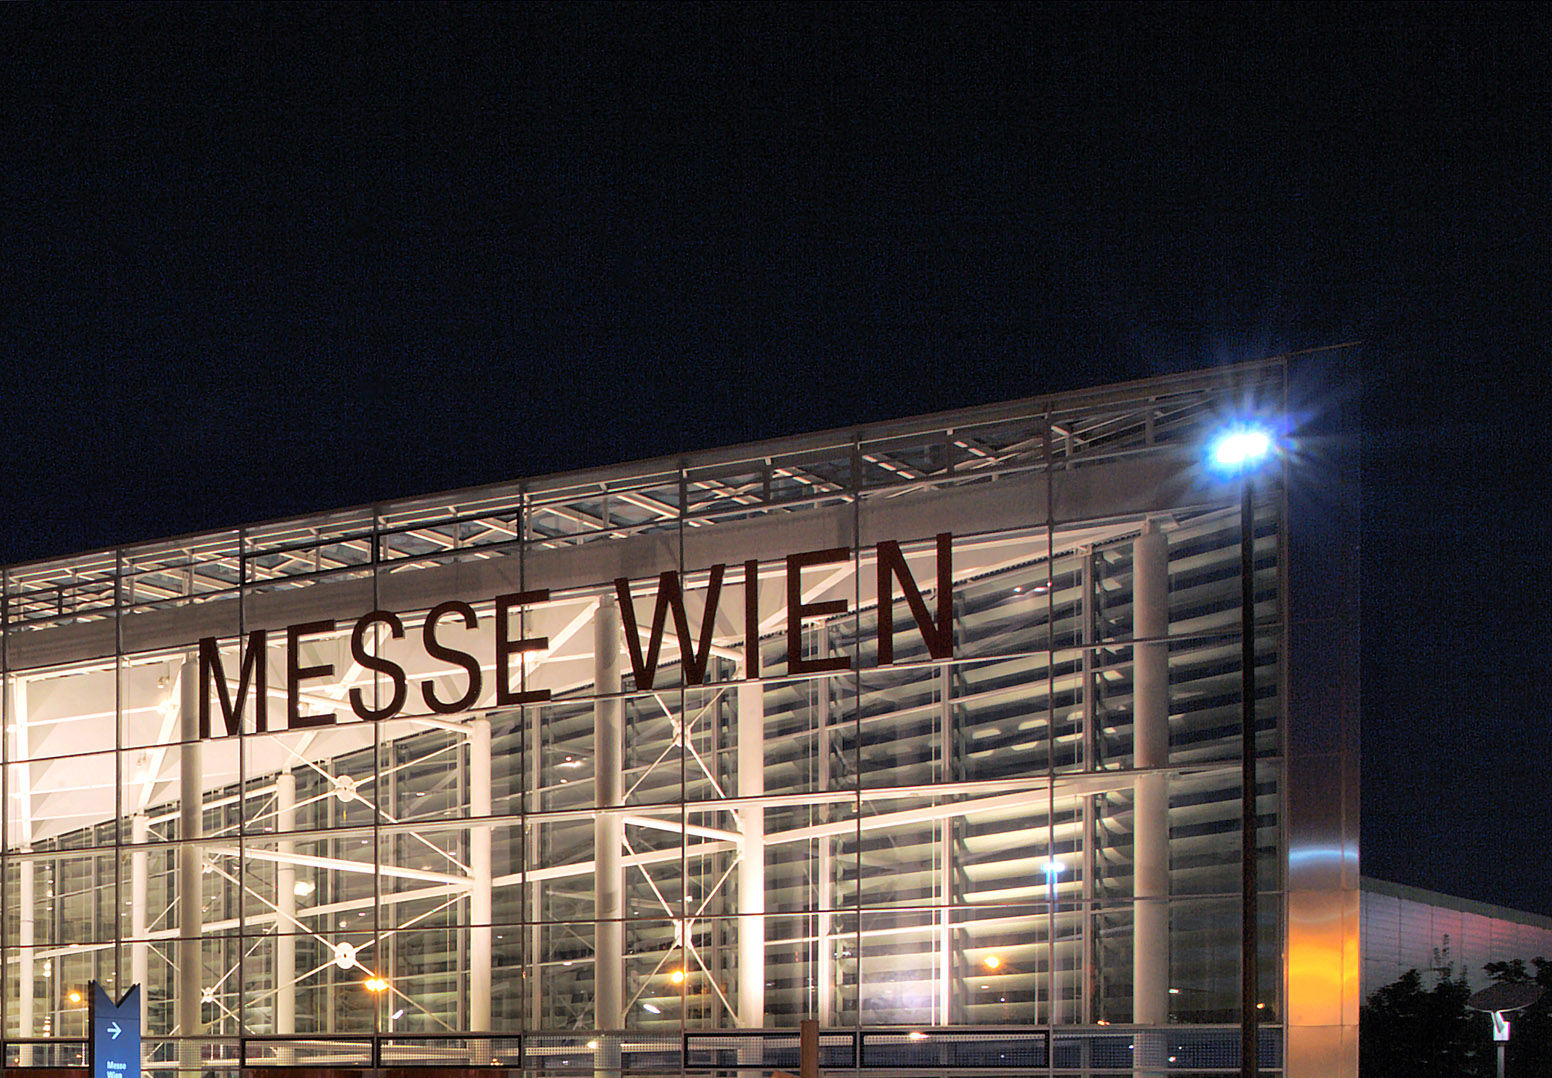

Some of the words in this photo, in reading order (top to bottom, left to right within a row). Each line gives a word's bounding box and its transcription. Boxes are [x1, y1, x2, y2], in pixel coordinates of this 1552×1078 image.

[199, 589, 551, 739] MESSE
[614, 532, 954, 691] WIEN
[107, 1061, 126, 1070] Messe
[107, 1071, 123, 1078] Wien
